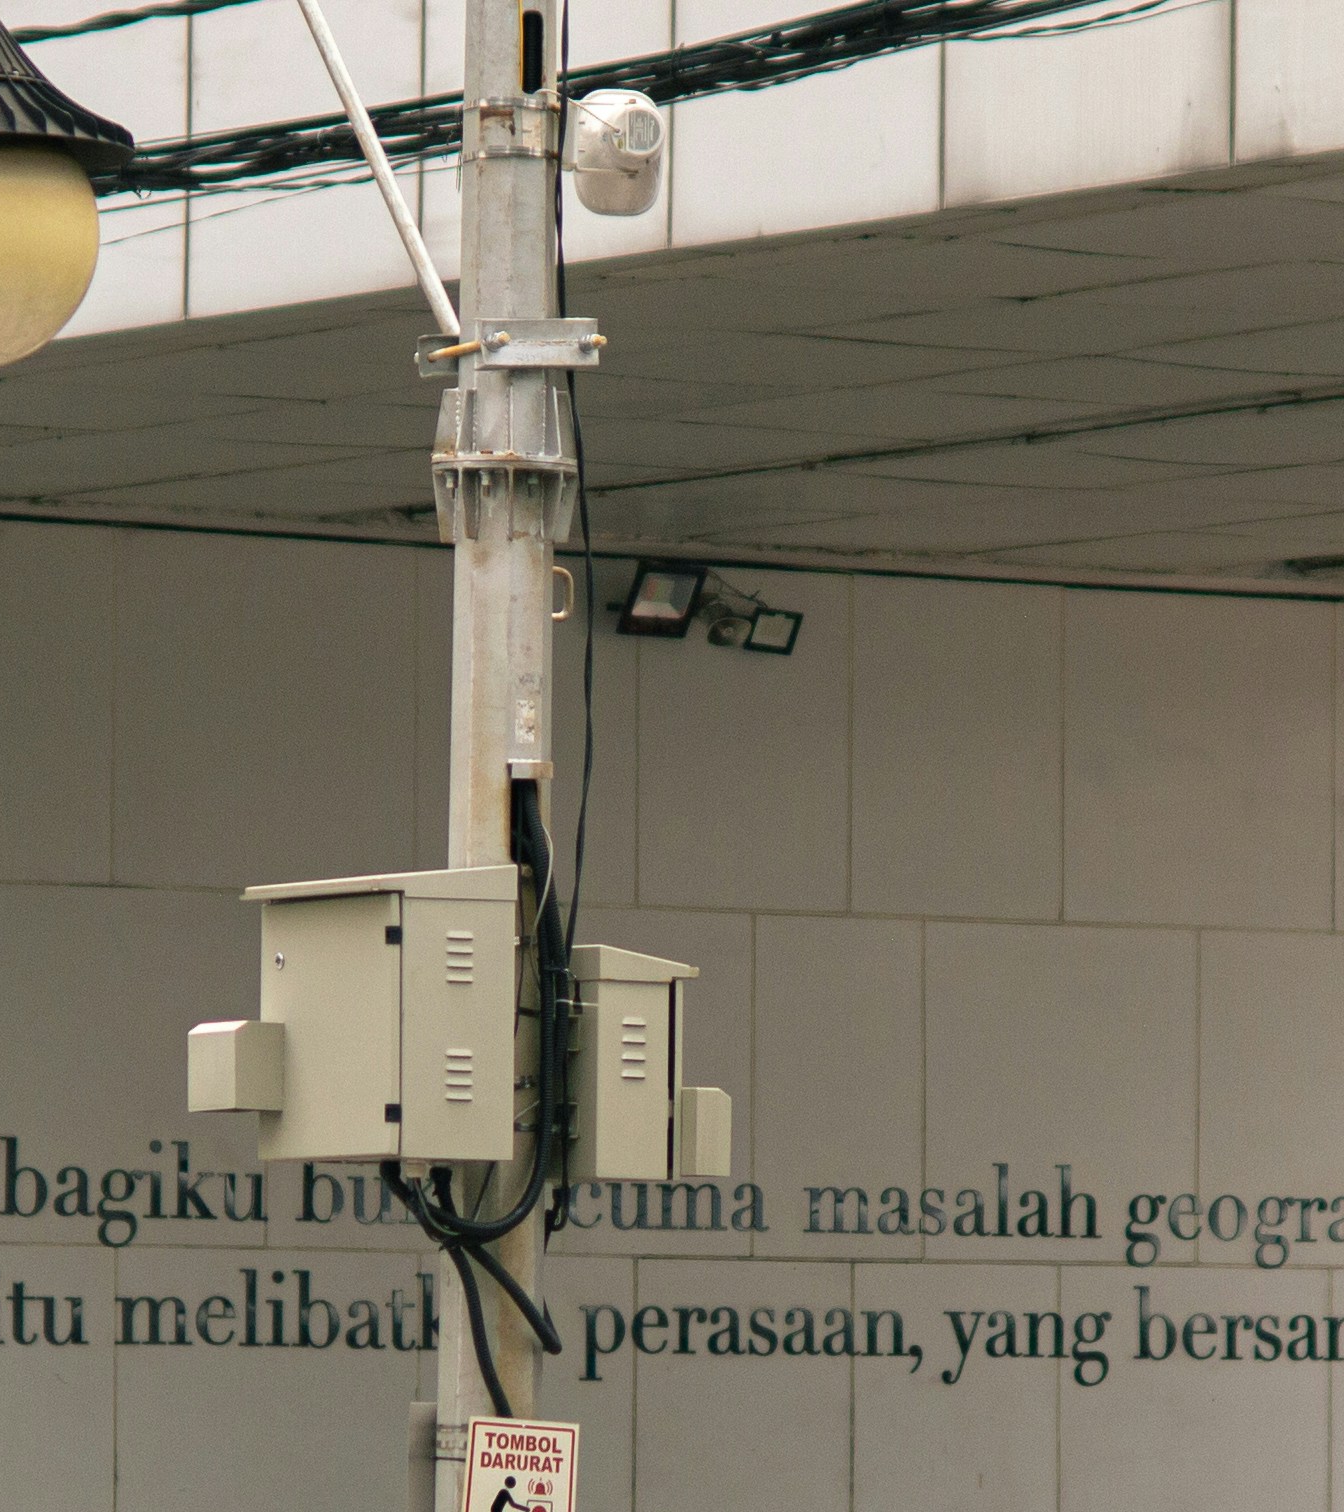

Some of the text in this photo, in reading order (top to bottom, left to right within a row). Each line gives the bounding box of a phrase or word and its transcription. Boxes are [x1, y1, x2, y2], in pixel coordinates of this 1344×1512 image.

[566, 1182, 770, 1233] cuma
[802, 1162, 1103, 1240] masalah
[578, 1303, 924, 1382] perasaan,
[940, 1307, 1113, 1387] yang
[480, 1451, 564, 1474] DARURAT
[484, 1432, 563, 1454] TOMBOL
